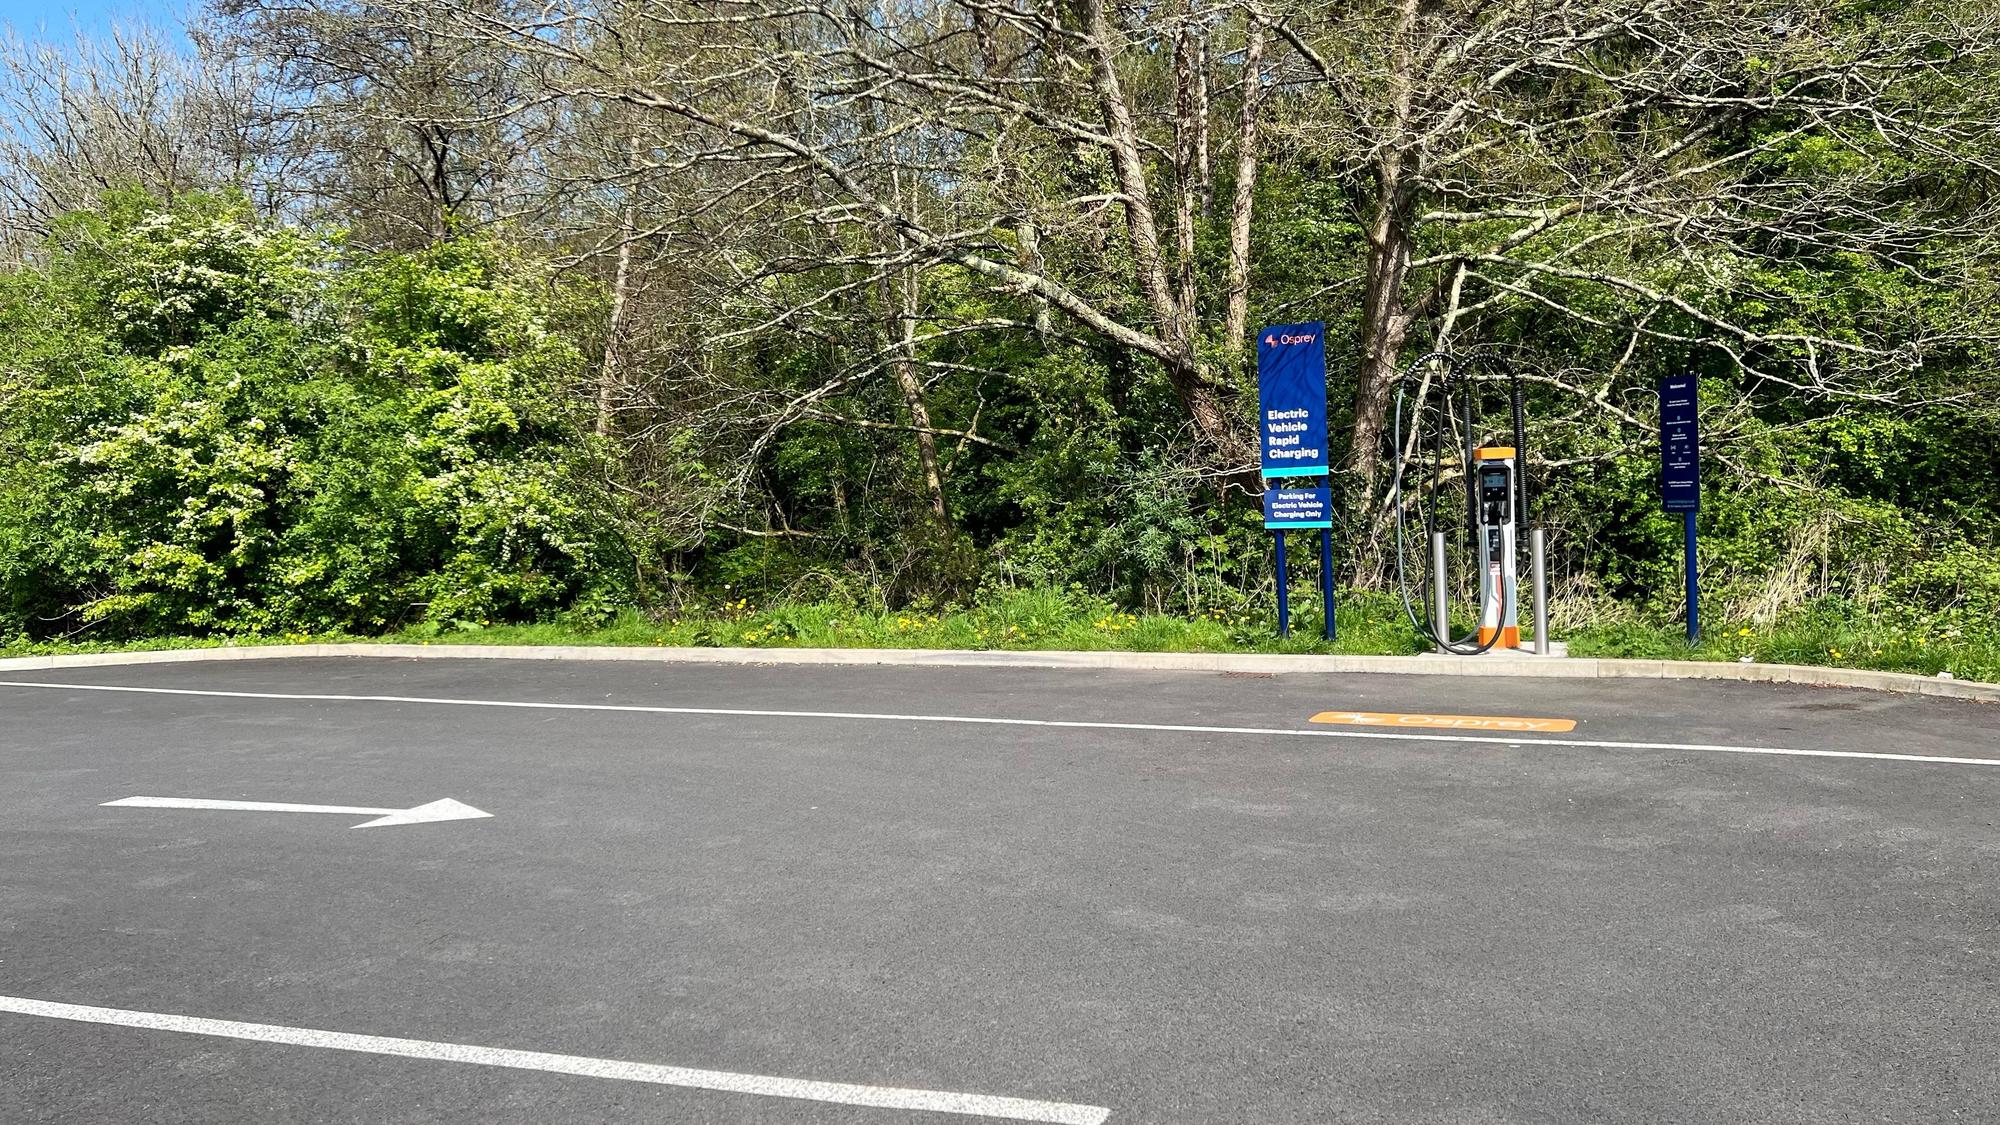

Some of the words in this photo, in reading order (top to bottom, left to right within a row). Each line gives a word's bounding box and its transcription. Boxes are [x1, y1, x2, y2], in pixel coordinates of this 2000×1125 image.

[1281, 334, 1315, 345] Osprey
[1268, 408, 1308, 420] Electric
[1268, 421, 1308, 433] Vehicle
[1268, 434, 1300, 447] Rapid
[1268, 447, 1319, 459] Charging
[1305, 510, 1321, 518] Only
[1398, 716, 1551, 729] Osprey
